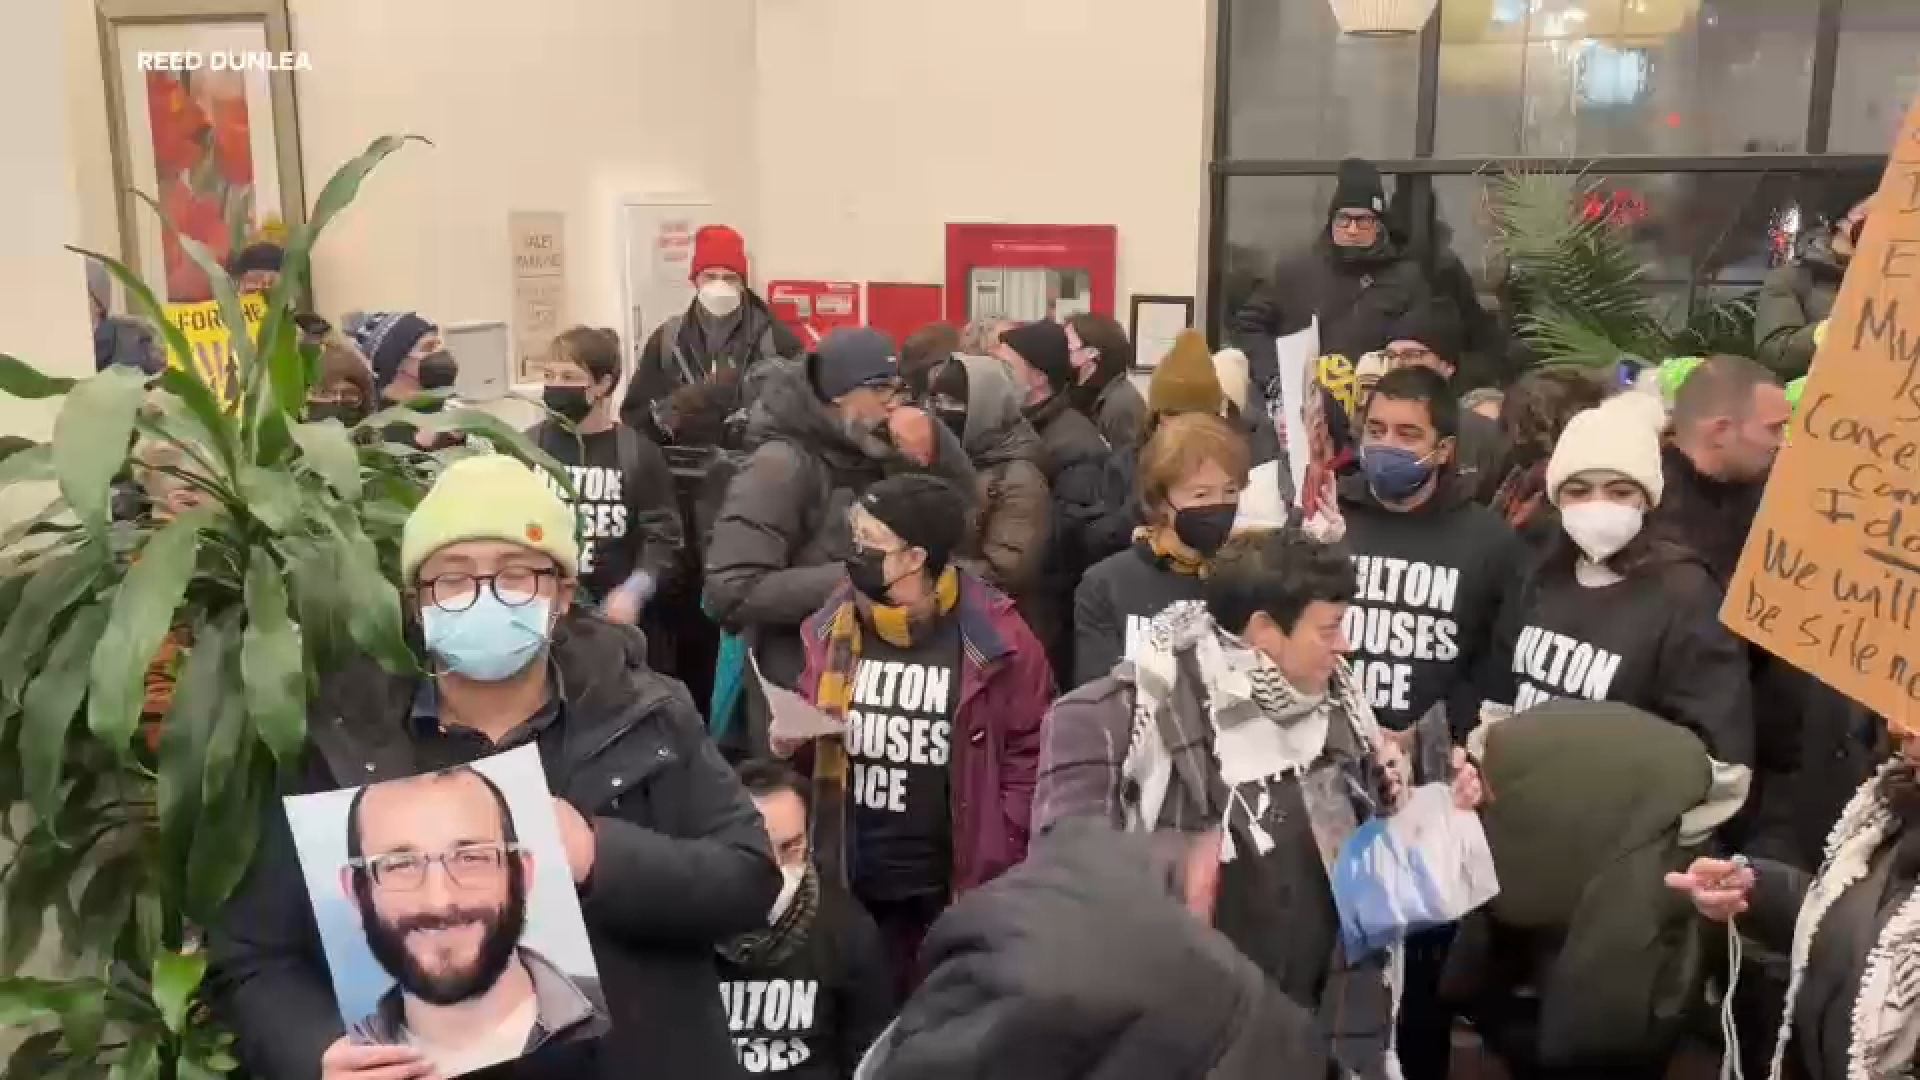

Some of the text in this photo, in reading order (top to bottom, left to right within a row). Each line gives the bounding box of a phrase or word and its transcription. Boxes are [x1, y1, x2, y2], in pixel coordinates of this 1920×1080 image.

[179, 309, 222, 331] FOR
[578, 503, 628, 538] SES
[1349, 555, 1459, 612] ILTON
[1746, 576, 1781, 633] be
[1764, 527, 1920, 631] We will
[1341, 605, 1459, 661] OUSES
[846, 709, 951, 766] OUSES
[854, 763, 909, 813] ICE
[718, 978, 819, 1031] ILTON
